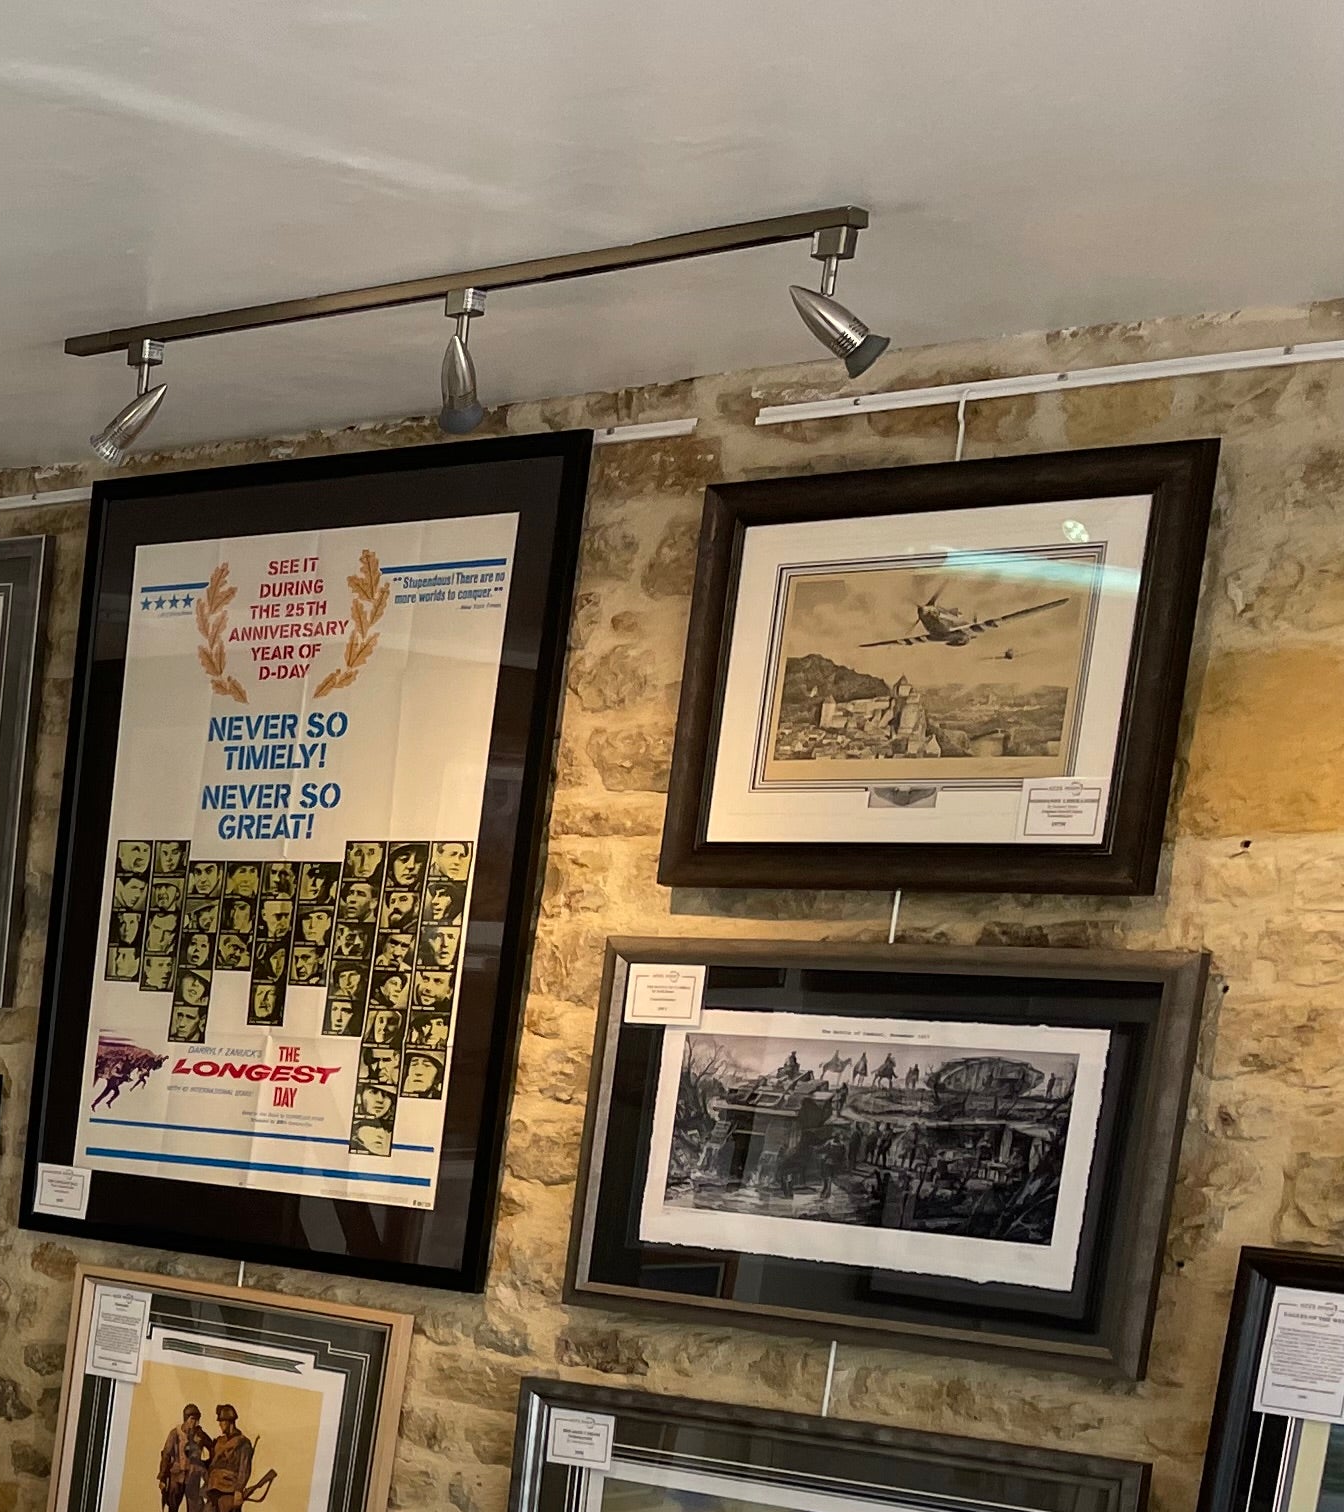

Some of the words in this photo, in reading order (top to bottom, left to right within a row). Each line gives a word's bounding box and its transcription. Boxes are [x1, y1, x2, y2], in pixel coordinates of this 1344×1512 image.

[268, 558, 299, 576] SEE
[303, 557, 319, 573] IT
[259, 578, 324, 599] DURING
[250, 603, 281, 620] THE
[285, 600, 328, 618] 25TH
[228, 620, 350, 642] ANNIVERSARY
[250, 644, 295, 661] YEAR
[298, 643, 322, 659] OF
[258, 664, 311, 681] D-DAY
[208, 713, 299, 742] NEVER
[306, 711, 349, 739] SO
[223, 742, 327, 771] TIMELY!
[201, 783, 292, 810] NEVER
[298, 782, 342, 809] SO
[217, 812, 315, 840] GREAT!
[278, 1045, 301, 1063] THE
[171, 1057, 343, 1085] LONGEST
[272, 1086, 298, 1109] DAY
